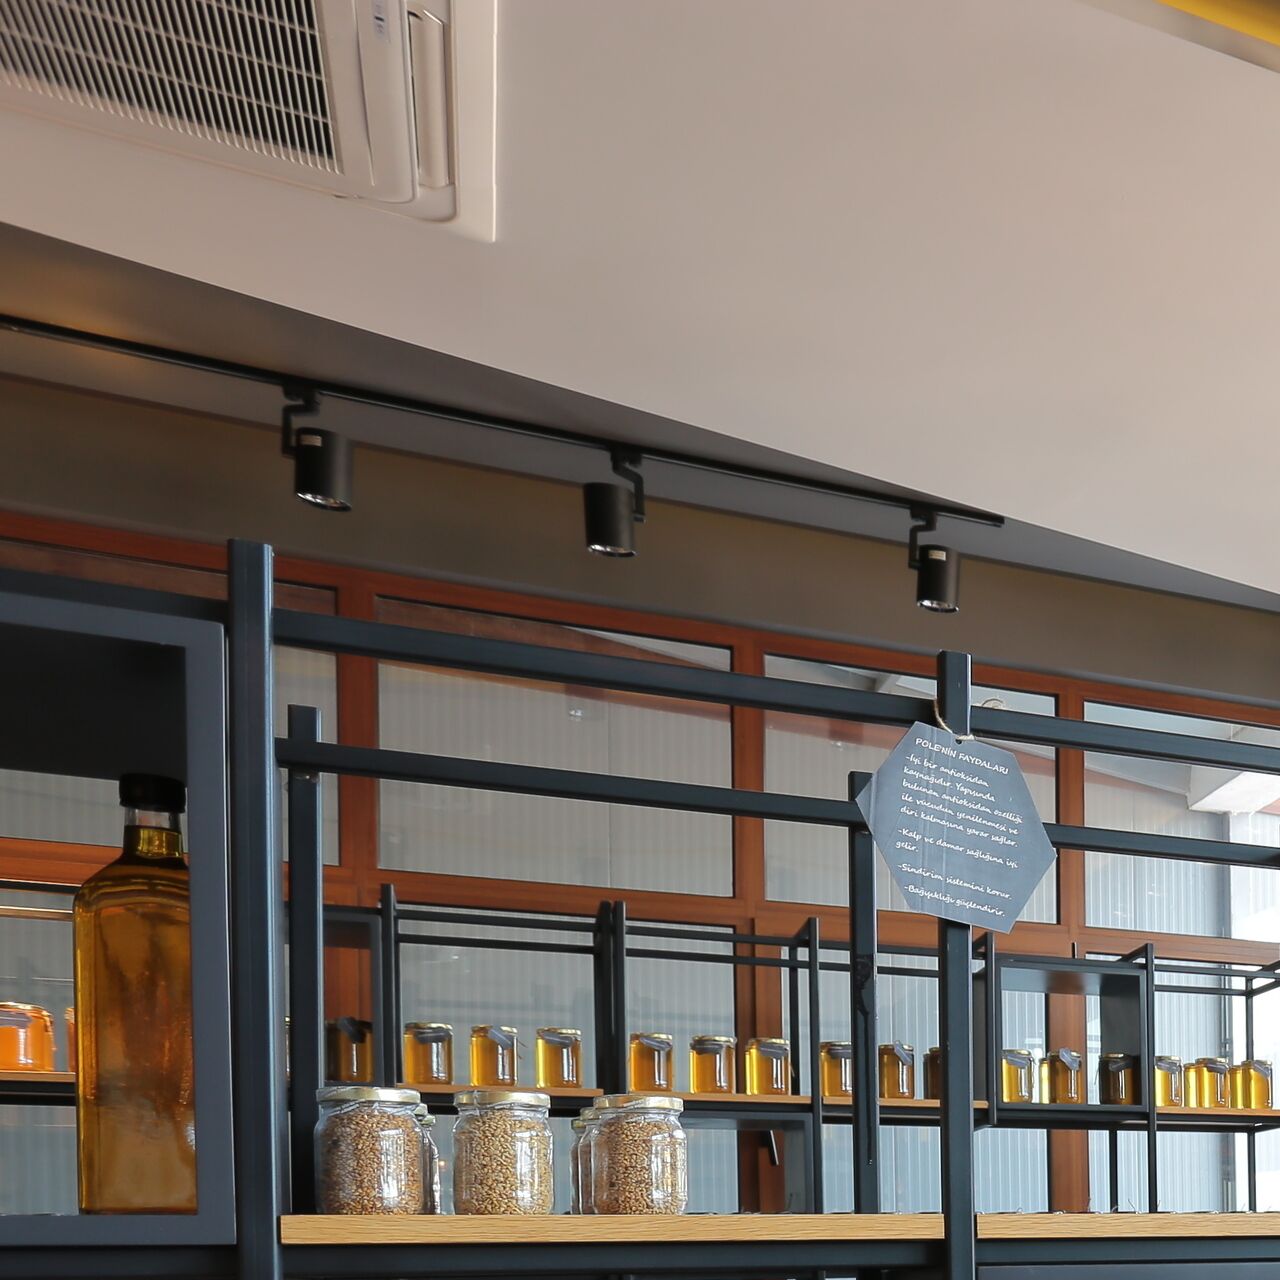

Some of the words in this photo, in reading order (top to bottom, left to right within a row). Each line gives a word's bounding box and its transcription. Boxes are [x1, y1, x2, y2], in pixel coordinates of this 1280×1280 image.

[923, 758, 938, 769] bir
[940, 766, 989, 787] antioksidan
[959, 752, 1009, 775] FAYDALARI
[902, 779, 939, 797] bulunan
[941, 794, 992, 814] antioksidan
[900, 806, 918, 817] diri
[966, 827, 989, 838] yarar
[991, 834, 1018, 847] sağlar.
[901, 793, 913, 802] ile
[956, 811, 1007, 832] yenilenmesi
[1008, 827, 1018, 835] ve
[895, 841, 919, 852] gelir.
[924, 836, 934, 844] ve
[935, 839, 964, 852] damar
[1005, 858, 1018, 868] iyi
[946, 876, 984, 893] sistemini
[986, 886, 1012, 900] korur.
